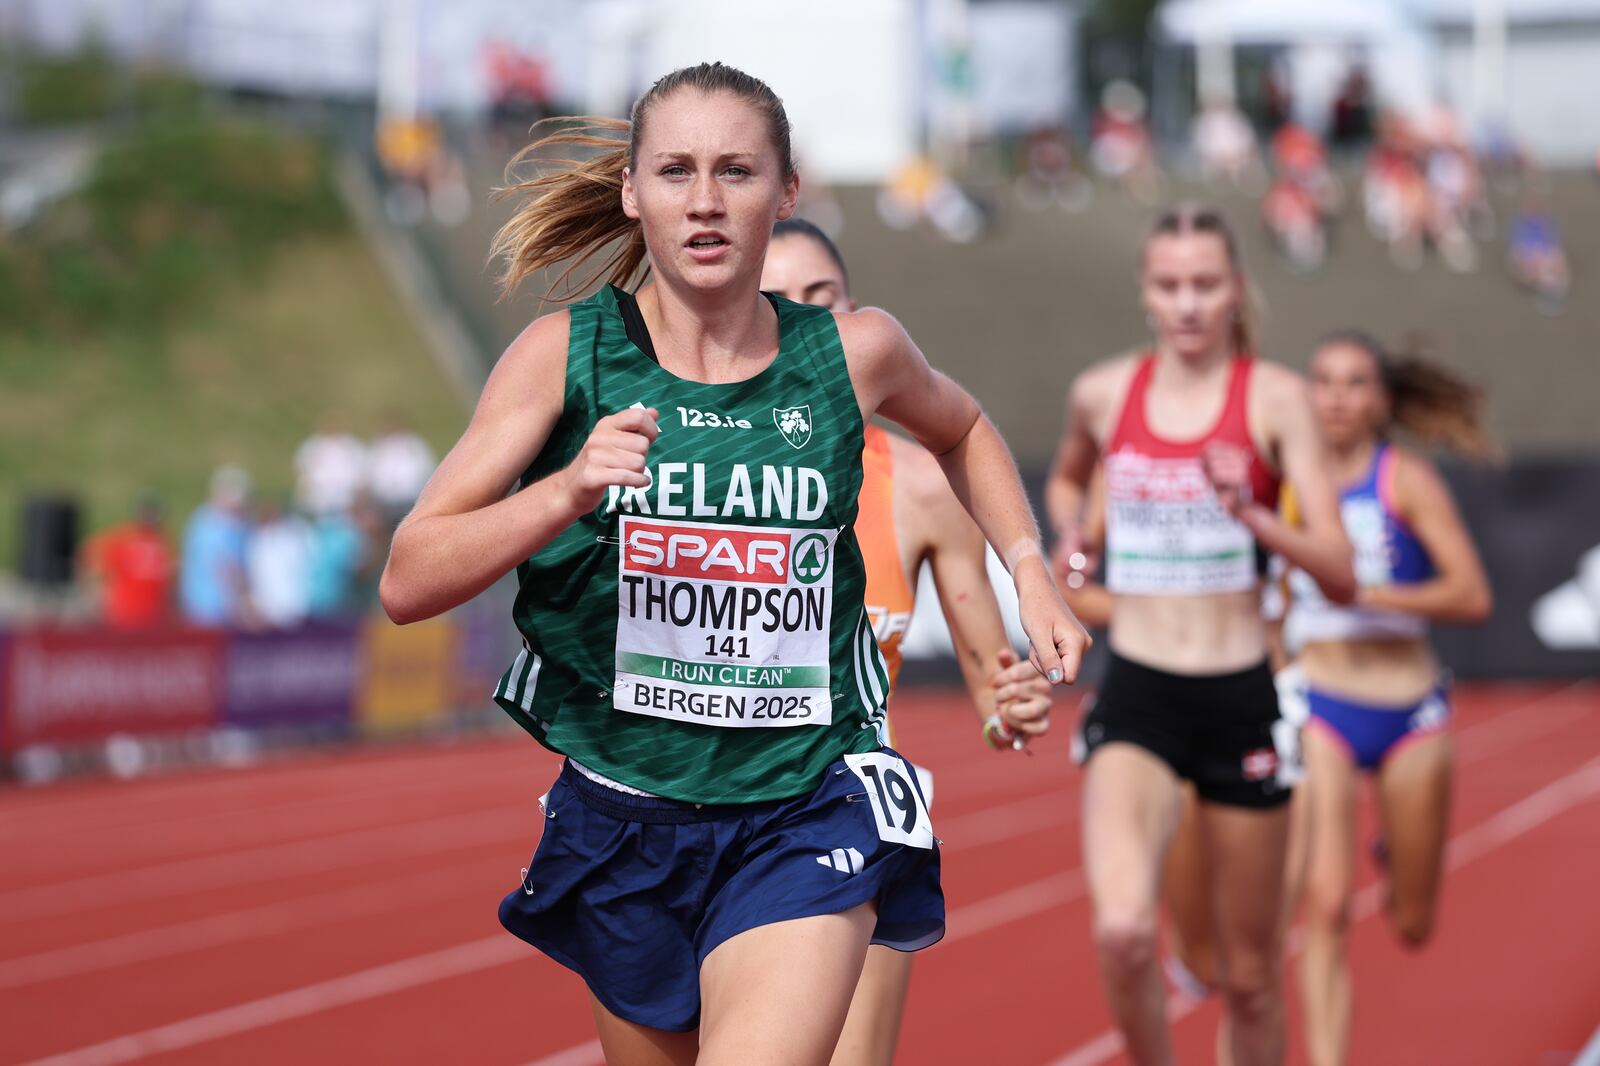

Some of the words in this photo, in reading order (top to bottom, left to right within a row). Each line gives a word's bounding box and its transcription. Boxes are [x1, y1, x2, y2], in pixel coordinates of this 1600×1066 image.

[677, 407, 752, 429] 123.ie
[629, 530, 785, 576] SPAR
[623, 576, 825, 632] THOMPSON
[705, 635, 750, 658] 141
[662, 660, 666, 676] I
[671, 662, 713, 683] RUN
[634, 684, 746, 718] BERGEN
[752, 696, 811, 718] 2025
[861, 764, 918, 835] 19
